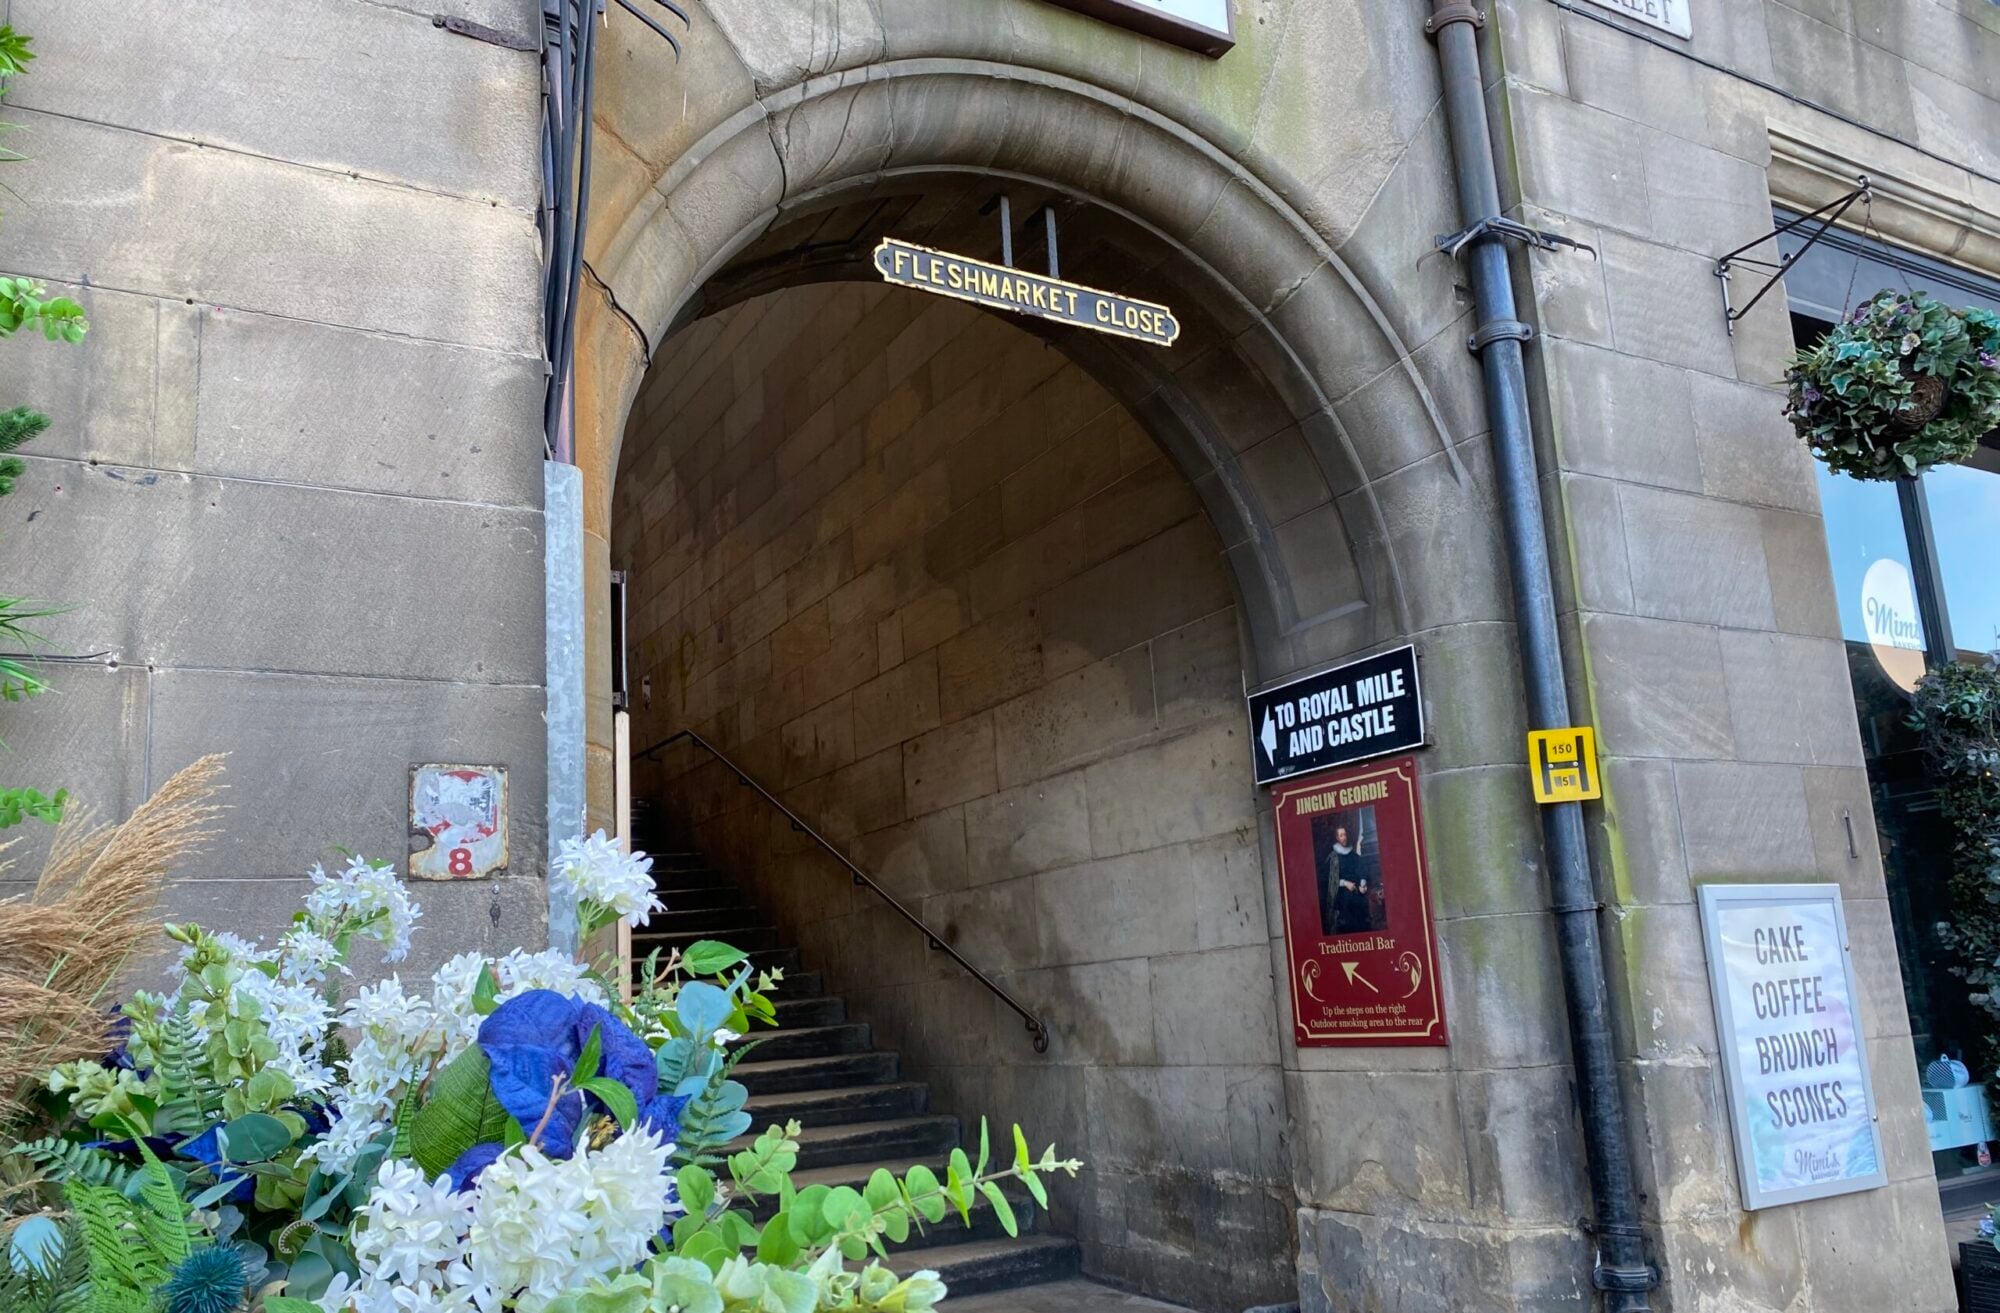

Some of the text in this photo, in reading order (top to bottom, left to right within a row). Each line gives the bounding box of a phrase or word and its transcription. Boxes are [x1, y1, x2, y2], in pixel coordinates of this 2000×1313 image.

[893, 250, 1167, 337] FLESHMARKET CLOSE
[1275, 668, 1406, 730] TO ROYAL MILE
[1289, 705, 1396, 758] AND CASTLE
[1552, 743, 1572, 755] 150
[1339, 780, 1389, 806] GEORDIE
[448, 847, 473, 877] 8
[1318, 937, 1395, 955] Traditional Bar
[1754, 925, 1808, 965] CAKE
[1322, 1003, 1406, 1017] Up the steps on the right
[1752, 976, 1826, 1020] COFFEE
[1310, 1016, 1423, 1029] Outdoor smoking area to the rear
[1755, 1027, 1839, 1075] BRUNCH
[1766, 1080, 1847, 1130] SCONES
